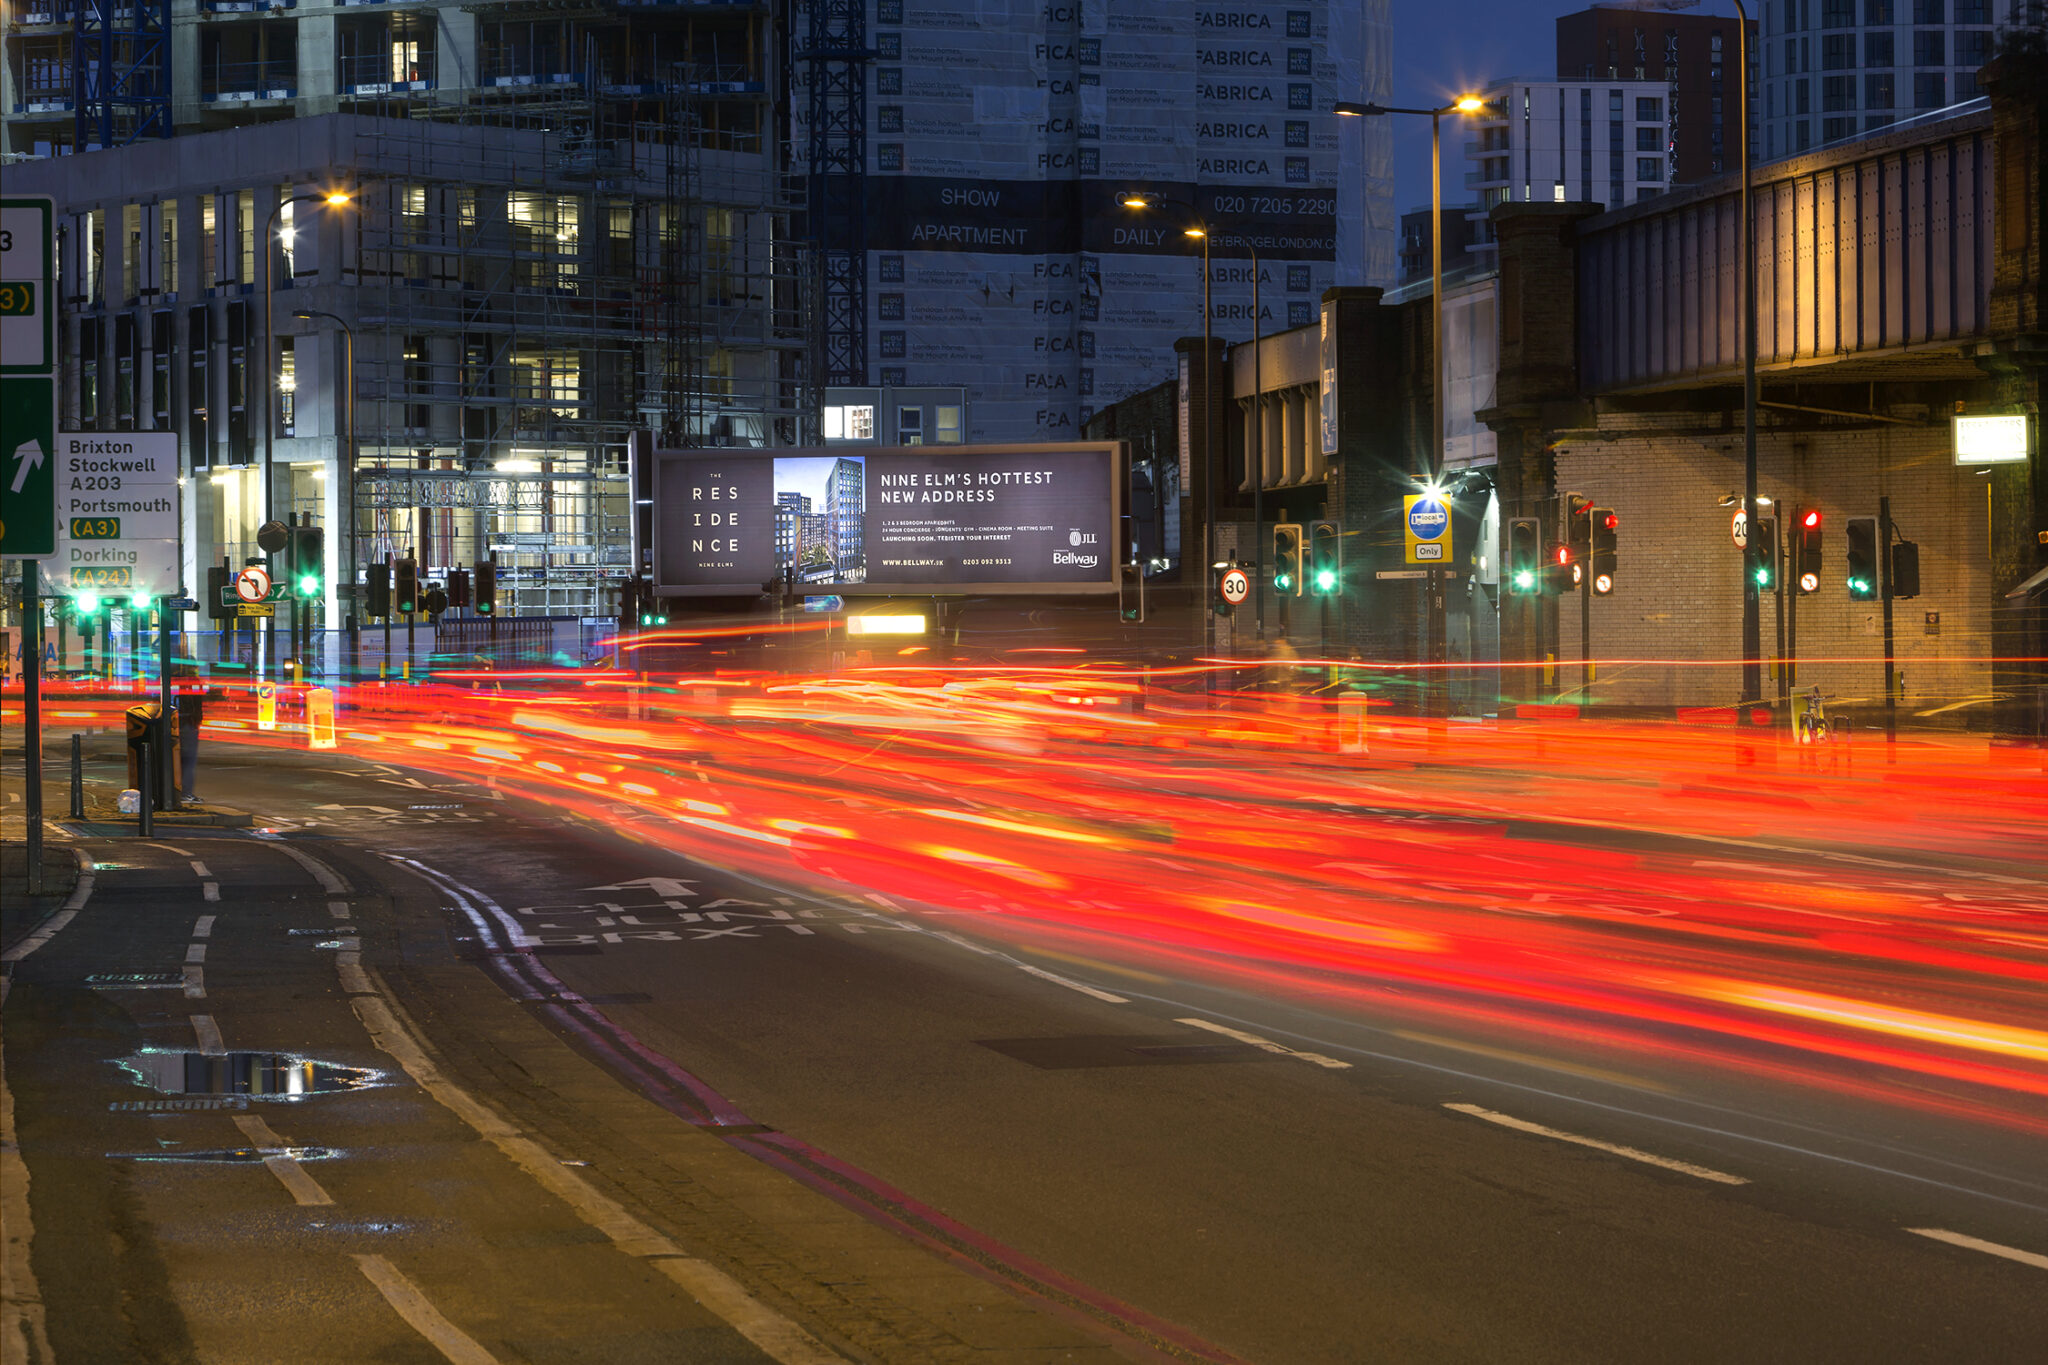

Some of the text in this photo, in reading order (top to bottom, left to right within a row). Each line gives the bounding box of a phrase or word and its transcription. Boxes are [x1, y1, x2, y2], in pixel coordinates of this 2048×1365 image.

[941, 188, 1000, 206] SHOW
[1214, 196, 1336, 215] 020 7205 2290
[912, 224, 1028, 246] APARTMENT
[1114, 228, 1166, 246] DAILY
[70, 440, 133, 454] Brixton
[69, 458, 156, 472] Stockwell
[70, 477, 121, 490] A203
[881, 472, 1052, 486] NINE ELM'S HOTTEST
[881, 489, 995, 503] NEW ADDRESS
[70, 498, 171, 512] Portsmouth
[73, 519, 118, 537] (A3)
[1082, 534, 1098, 544] JLL
[70, 548, 138, 564] Dorking
[1053, 552, 1098, 568] Bellway
[73, 568, 130, 586] (A24)
[1225, 580, 1245, 594] 30
